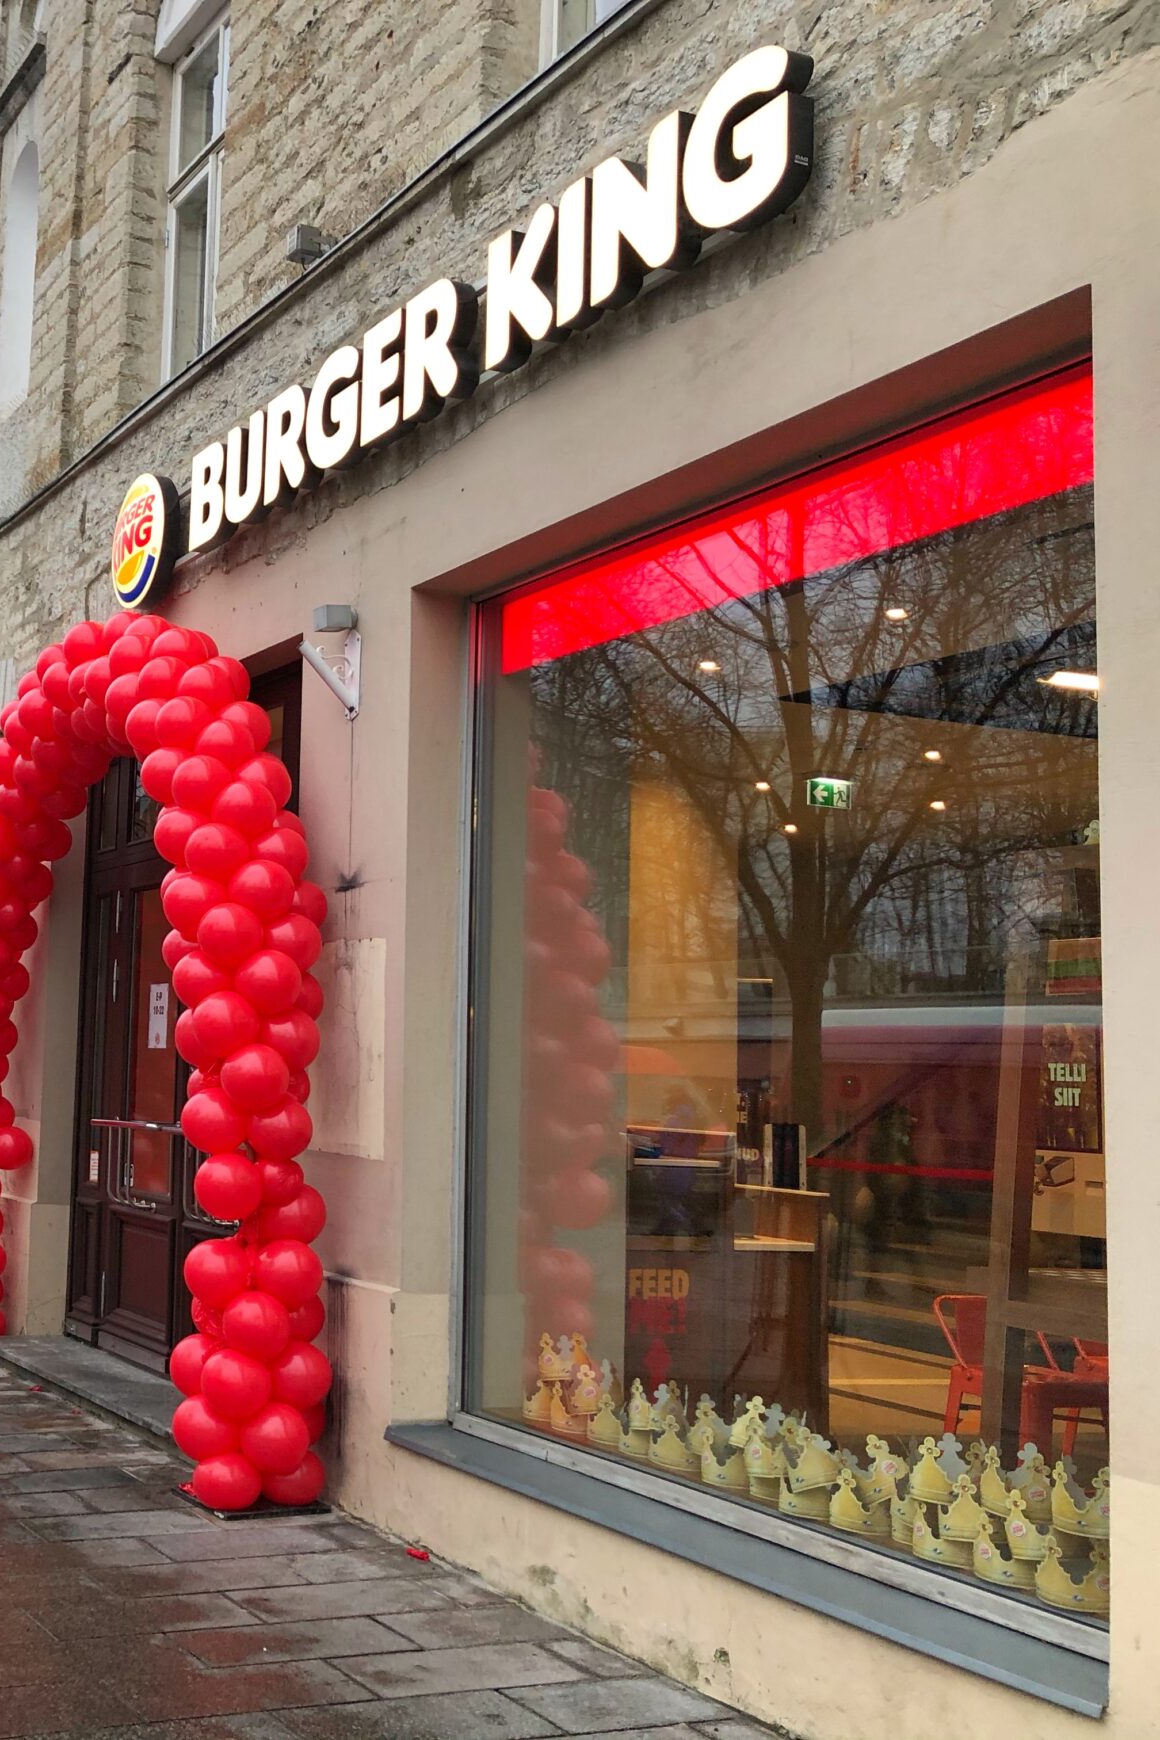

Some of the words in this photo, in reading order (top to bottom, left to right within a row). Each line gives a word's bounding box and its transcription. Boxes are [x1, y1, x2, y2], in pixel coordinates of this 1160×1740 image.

[188, 278, 461, 554] BURGER
[485, 45, 791, 372] KING
[1047, 1062, 1087, 1082] TELLI
[1054, 1087, 1081, 1107] SIIT
[628, 1268, 690, 1299] FEED
